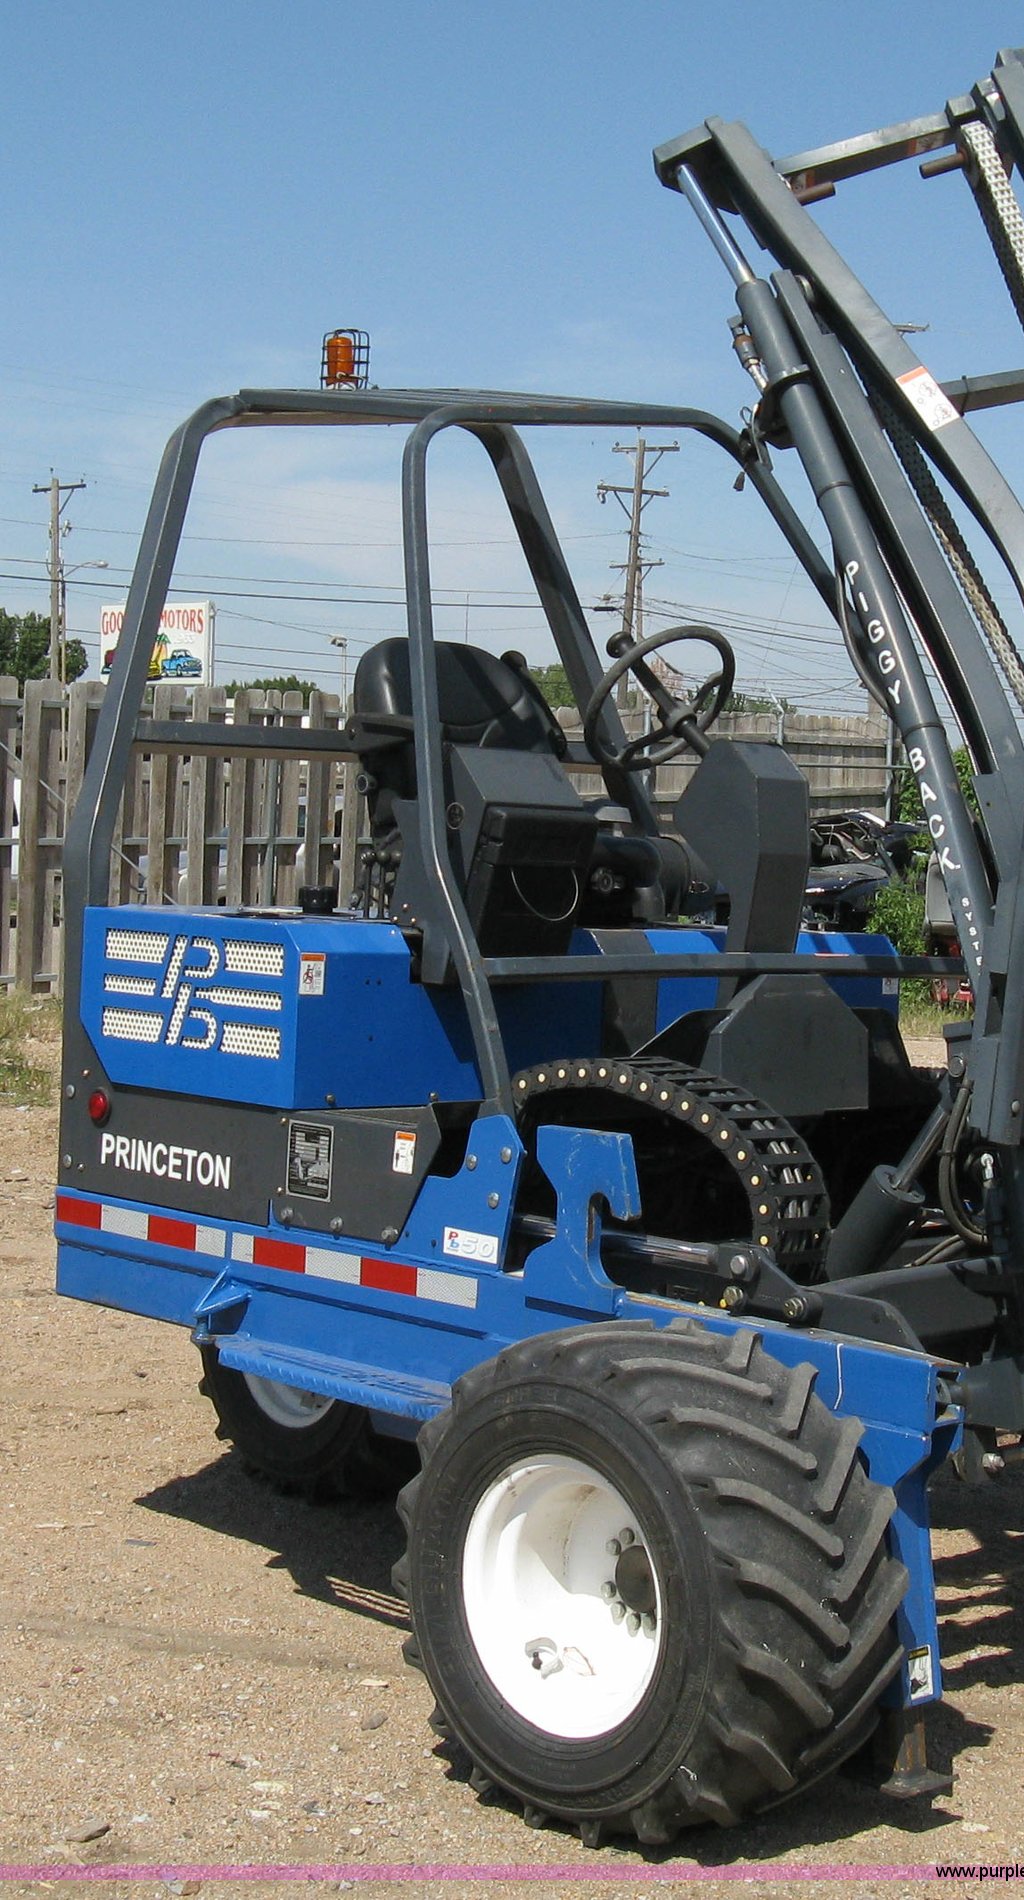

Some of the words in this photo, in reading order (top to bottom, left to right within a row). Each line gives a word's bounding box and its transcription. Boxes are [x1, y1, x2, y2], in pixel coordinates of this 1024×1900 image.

[101, 611, 126, 636] GOO
[159, 608, 205, 635] MOTORS
[845, 560, 902, 705] PIGGY
[908, 747, 962, 875] BACK
[961, 896, 983, 976] SYSTE
[100, 1132, 231, 1190] PRINCETON
